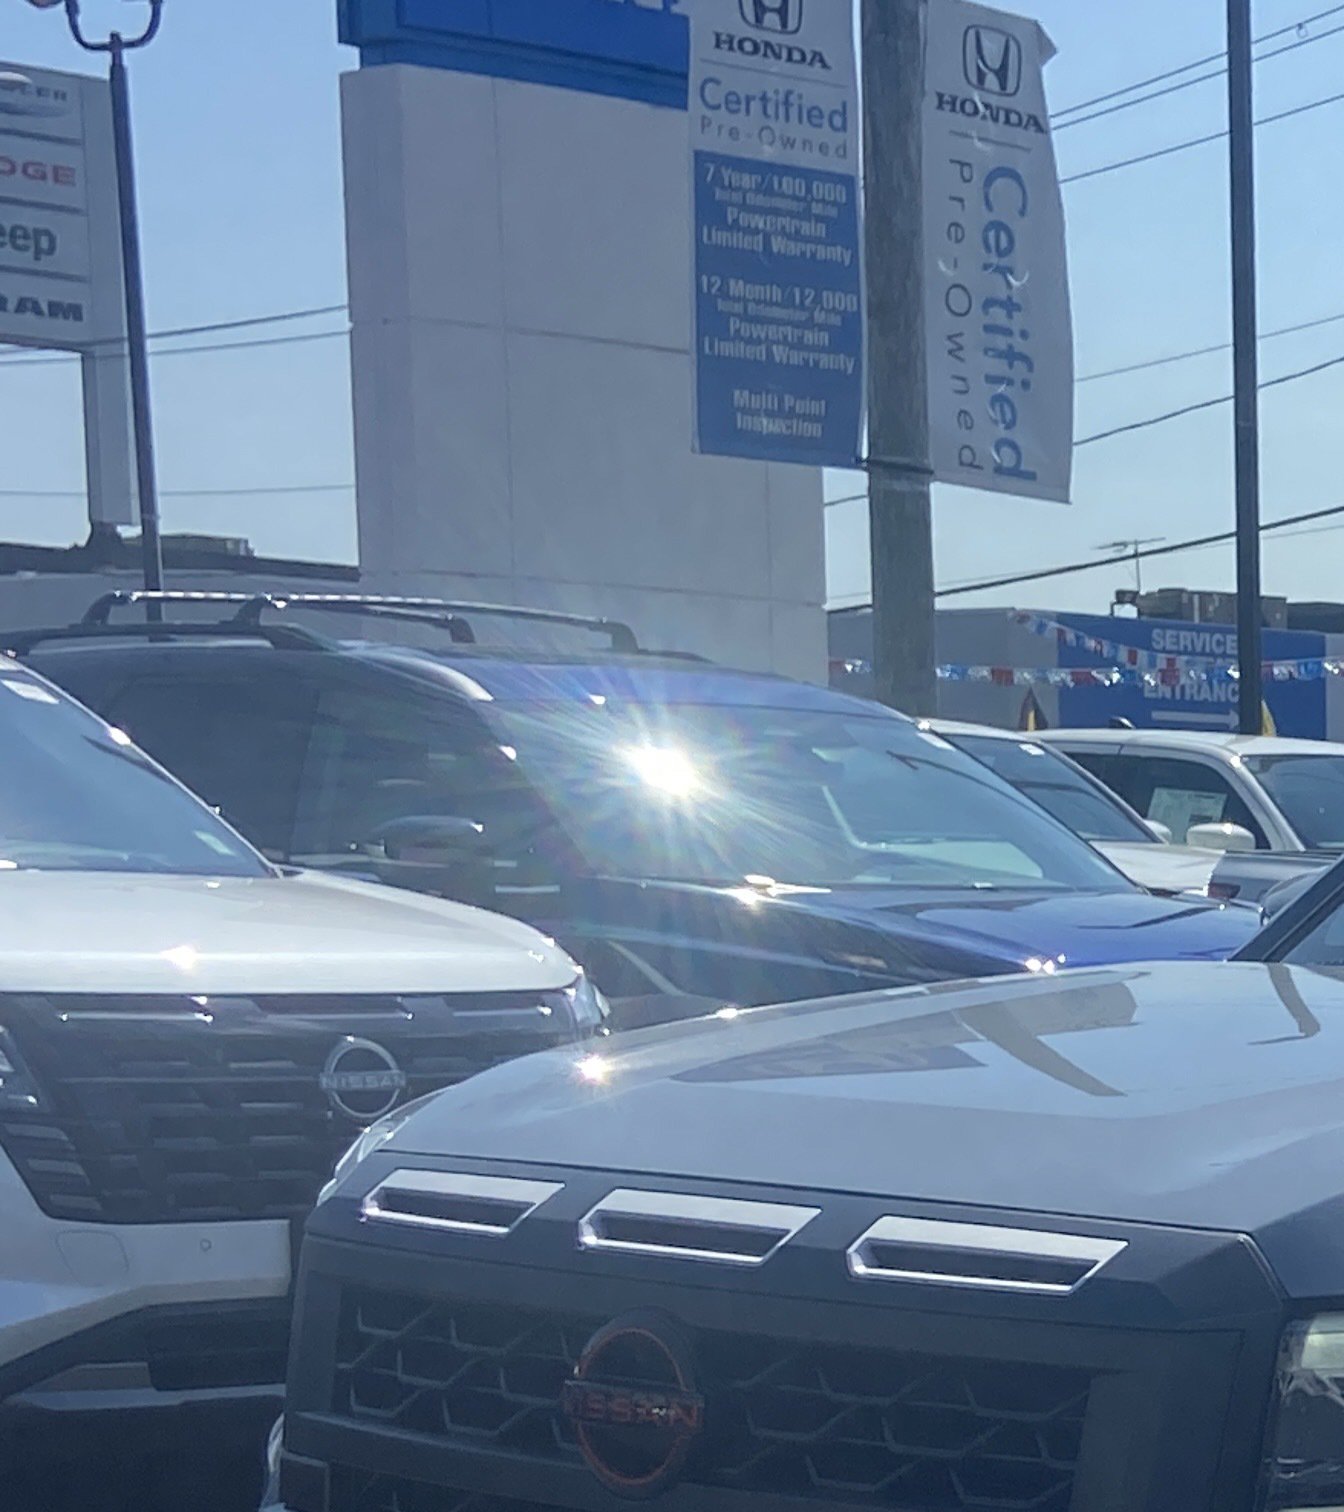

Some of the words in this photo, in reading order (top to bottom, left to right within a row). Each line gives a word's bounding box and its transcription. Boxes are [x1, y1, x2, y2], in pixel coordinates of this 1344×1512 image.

[712, 31, 832, 71] HONDA
[700, 77, 848, 133] Certified
[936, 92, 1048, 134] HONDA
[700, 115, 848, 160] Pre-Owned
[703, 162, 715, 183] 7
[727, 206, 826, 238] Powertrain
[703, 224, 763, 252] Limited
[770, 235, 852, 267] Warranty
[701, 274, 721, 295] 12
[944, 158, 983, 471] Pre-Owned
[981, 166, 1038, 481] Certified
[729, 316, 829, 347] Powertrain
[704, 335, 767, 363] Limited
[772, 344, 855, 375] Warranty
[733, 389, 778, 412] Multi
[784, 393, 826, 417] Point
[736, 412, 823, 438] Inspection
[1151, 627, 1239, 655] SERVICE
[1142, 677, 1240, 704] ENTRANC
[320, 1074, 406, 1090] NISSAN
